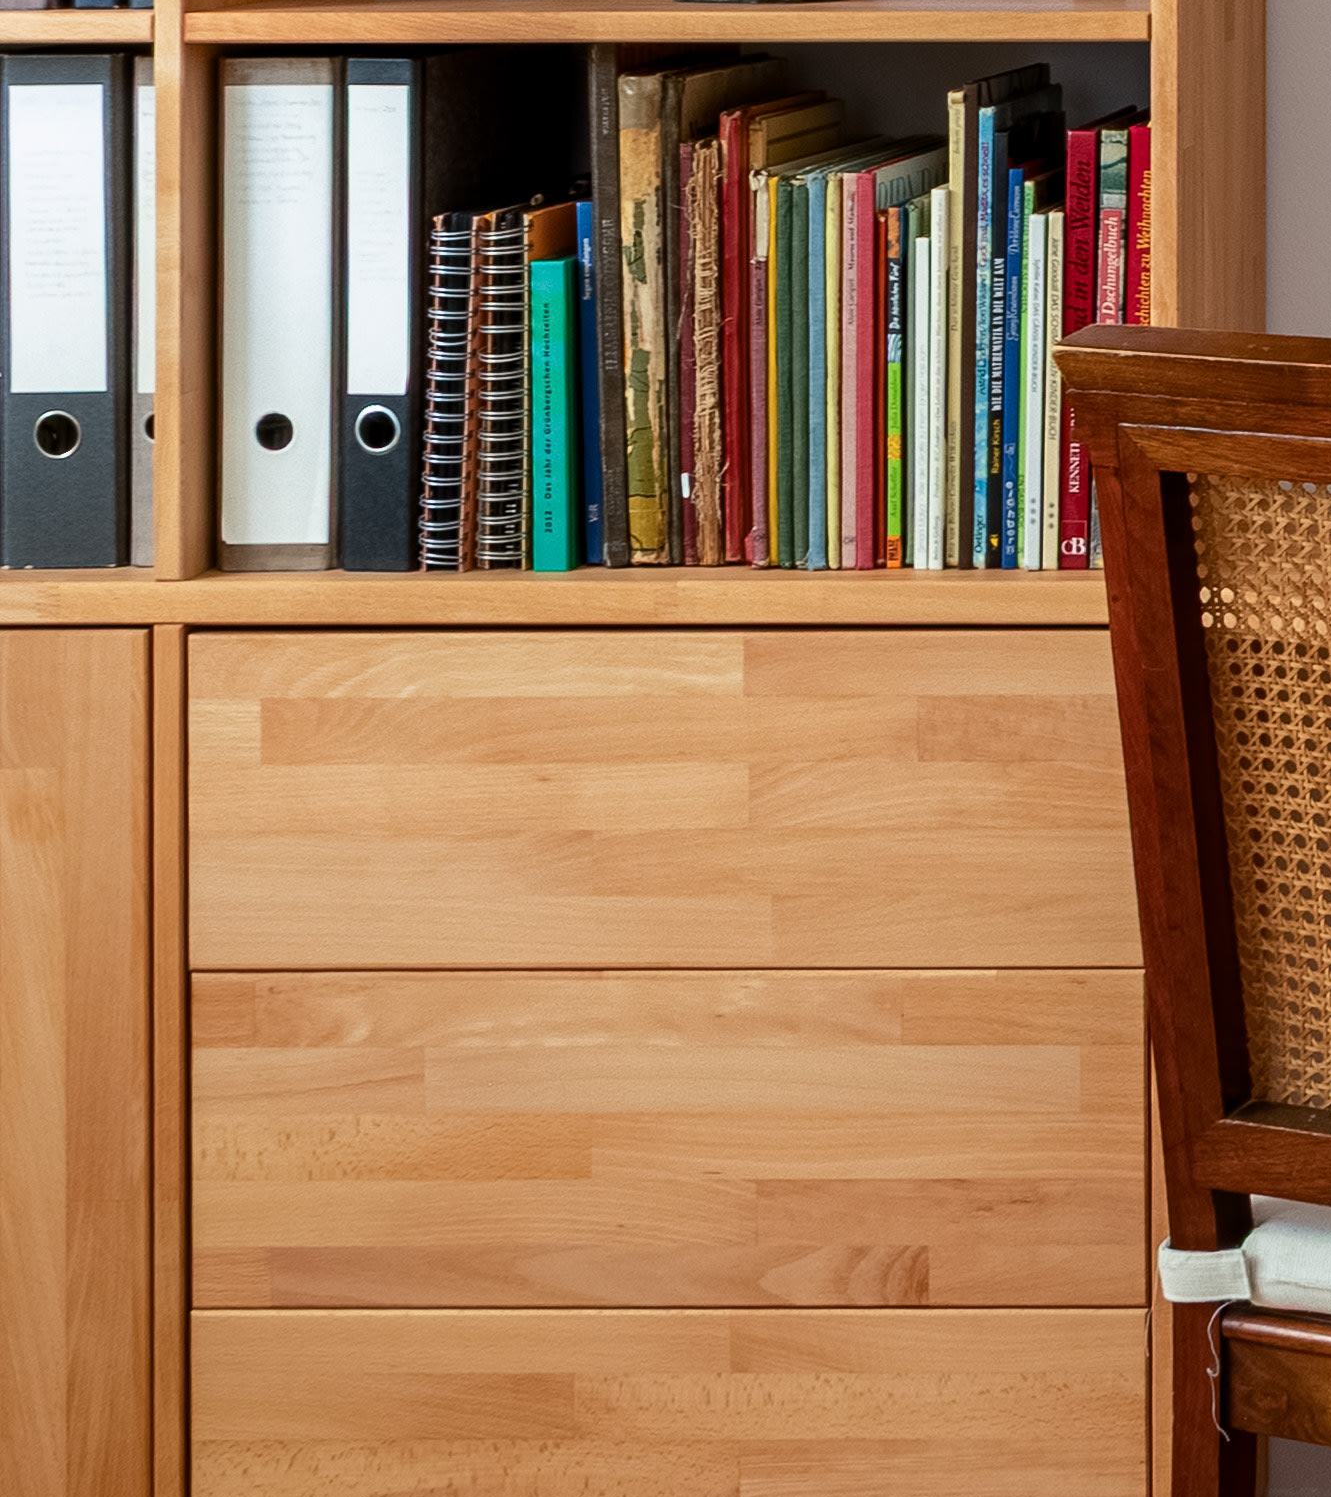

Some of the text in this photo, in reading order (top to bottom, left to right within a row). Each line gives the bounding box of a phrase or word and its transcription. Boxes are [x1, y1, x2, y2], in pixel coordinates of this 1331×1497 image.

[1066, 160, 1091, 301] in den Weiden
[1102, 217, 1120, 316] Dschungelbuch
[541, 303, 553, 533] 2012 Das Jahr der Grünbergschen Hochzeiten
[992, 420, 1000, 474] Rainer Kirsch
[975, 515, 986, 554] Oetinger
